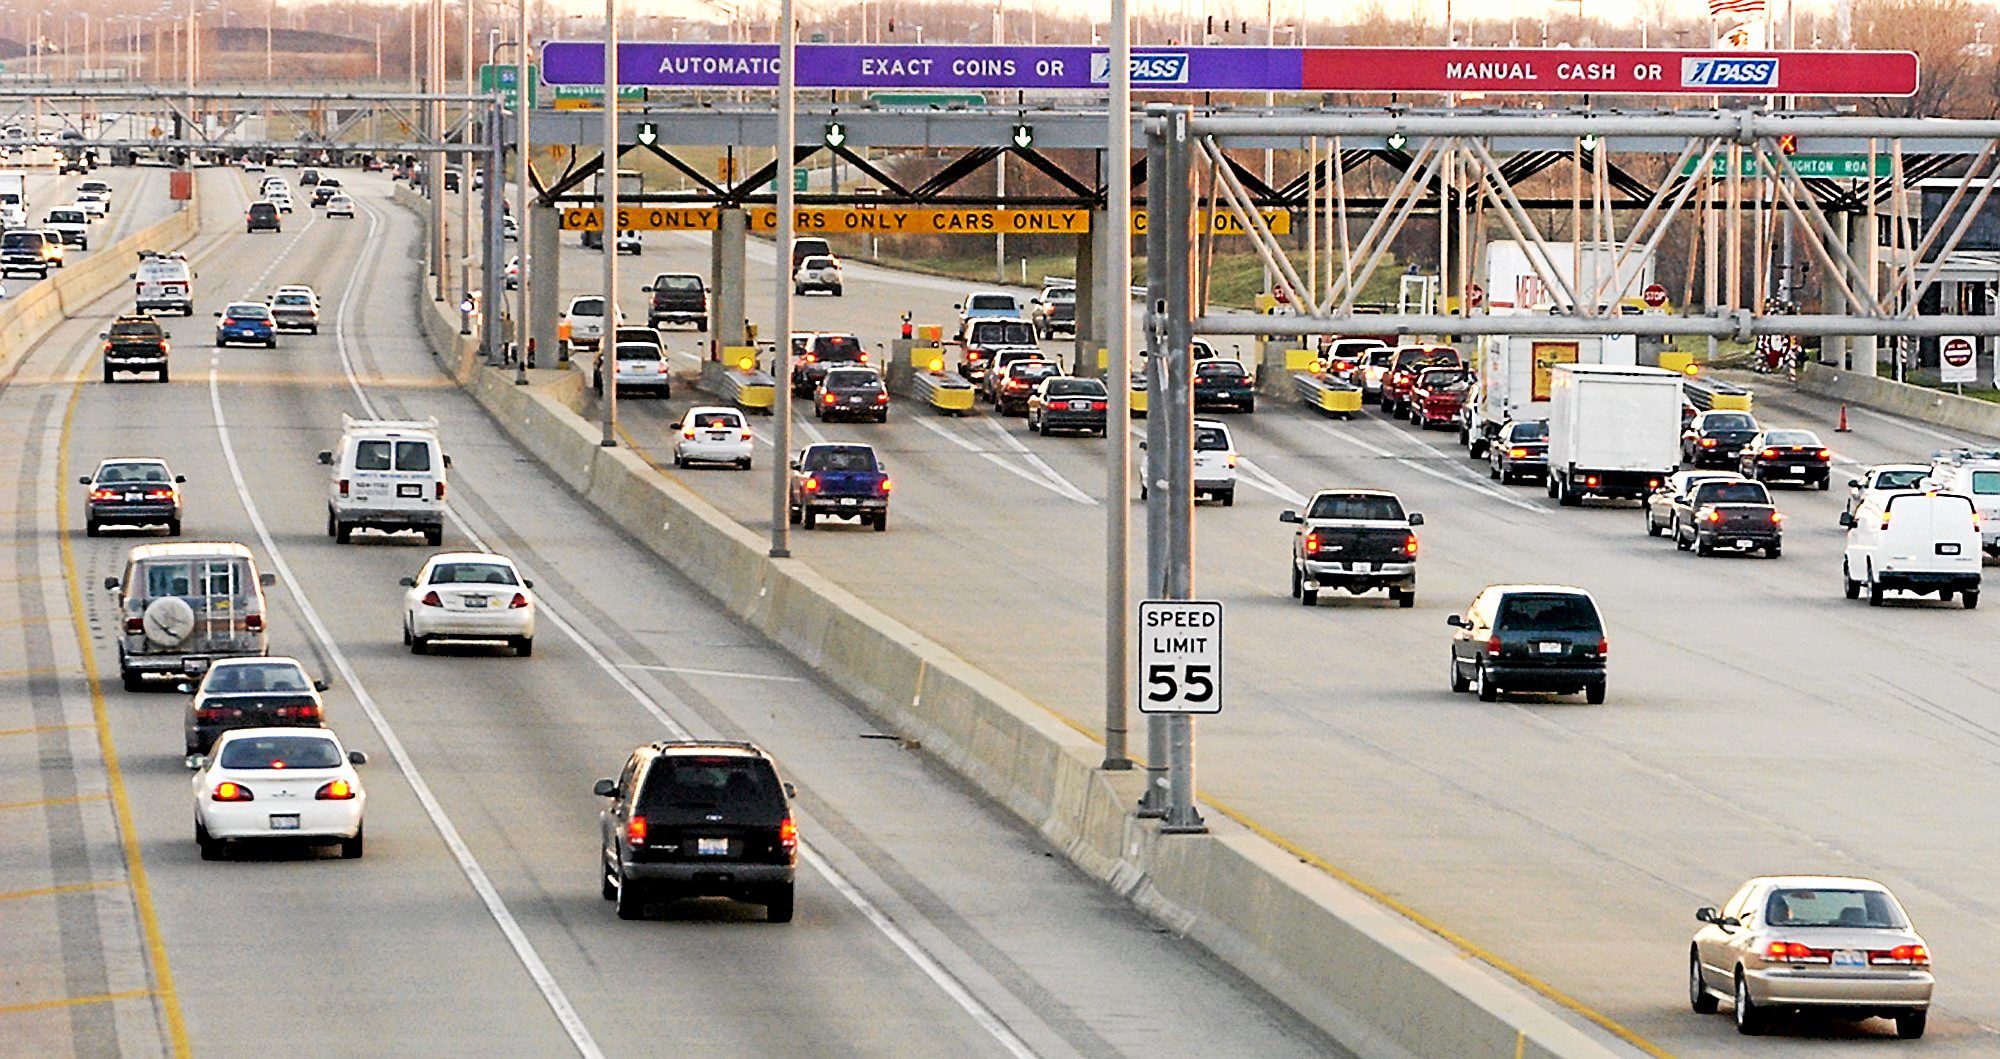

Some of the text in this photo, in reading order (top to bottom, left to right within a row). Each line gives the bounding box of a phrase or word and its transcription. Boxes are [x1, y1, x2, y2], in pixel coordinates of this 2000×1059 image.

[658, 57, 780, 74] AUTOMATIC
[862, 59, 933, 75] EXACT
[952, 59, 1016, 76] COINS
[1036, 60, 1064, 76] OR
[1446, 62, 1537, 80] MANUAL
[1557, 63, 1616, 80] CASH
[1633, 63, 1662, 80] OR
[1844, 161, 1868, 172] ROA
[568, 211, 712, 228] CAS ONLY
[764, 212, 1076, 230] CRS ONLY CARS ONLY
[1147, 611, 1216, 627] SPEED
[1153, 637, 1208, 653] LIMIT
[1148, 664, 1214, 703] 55
